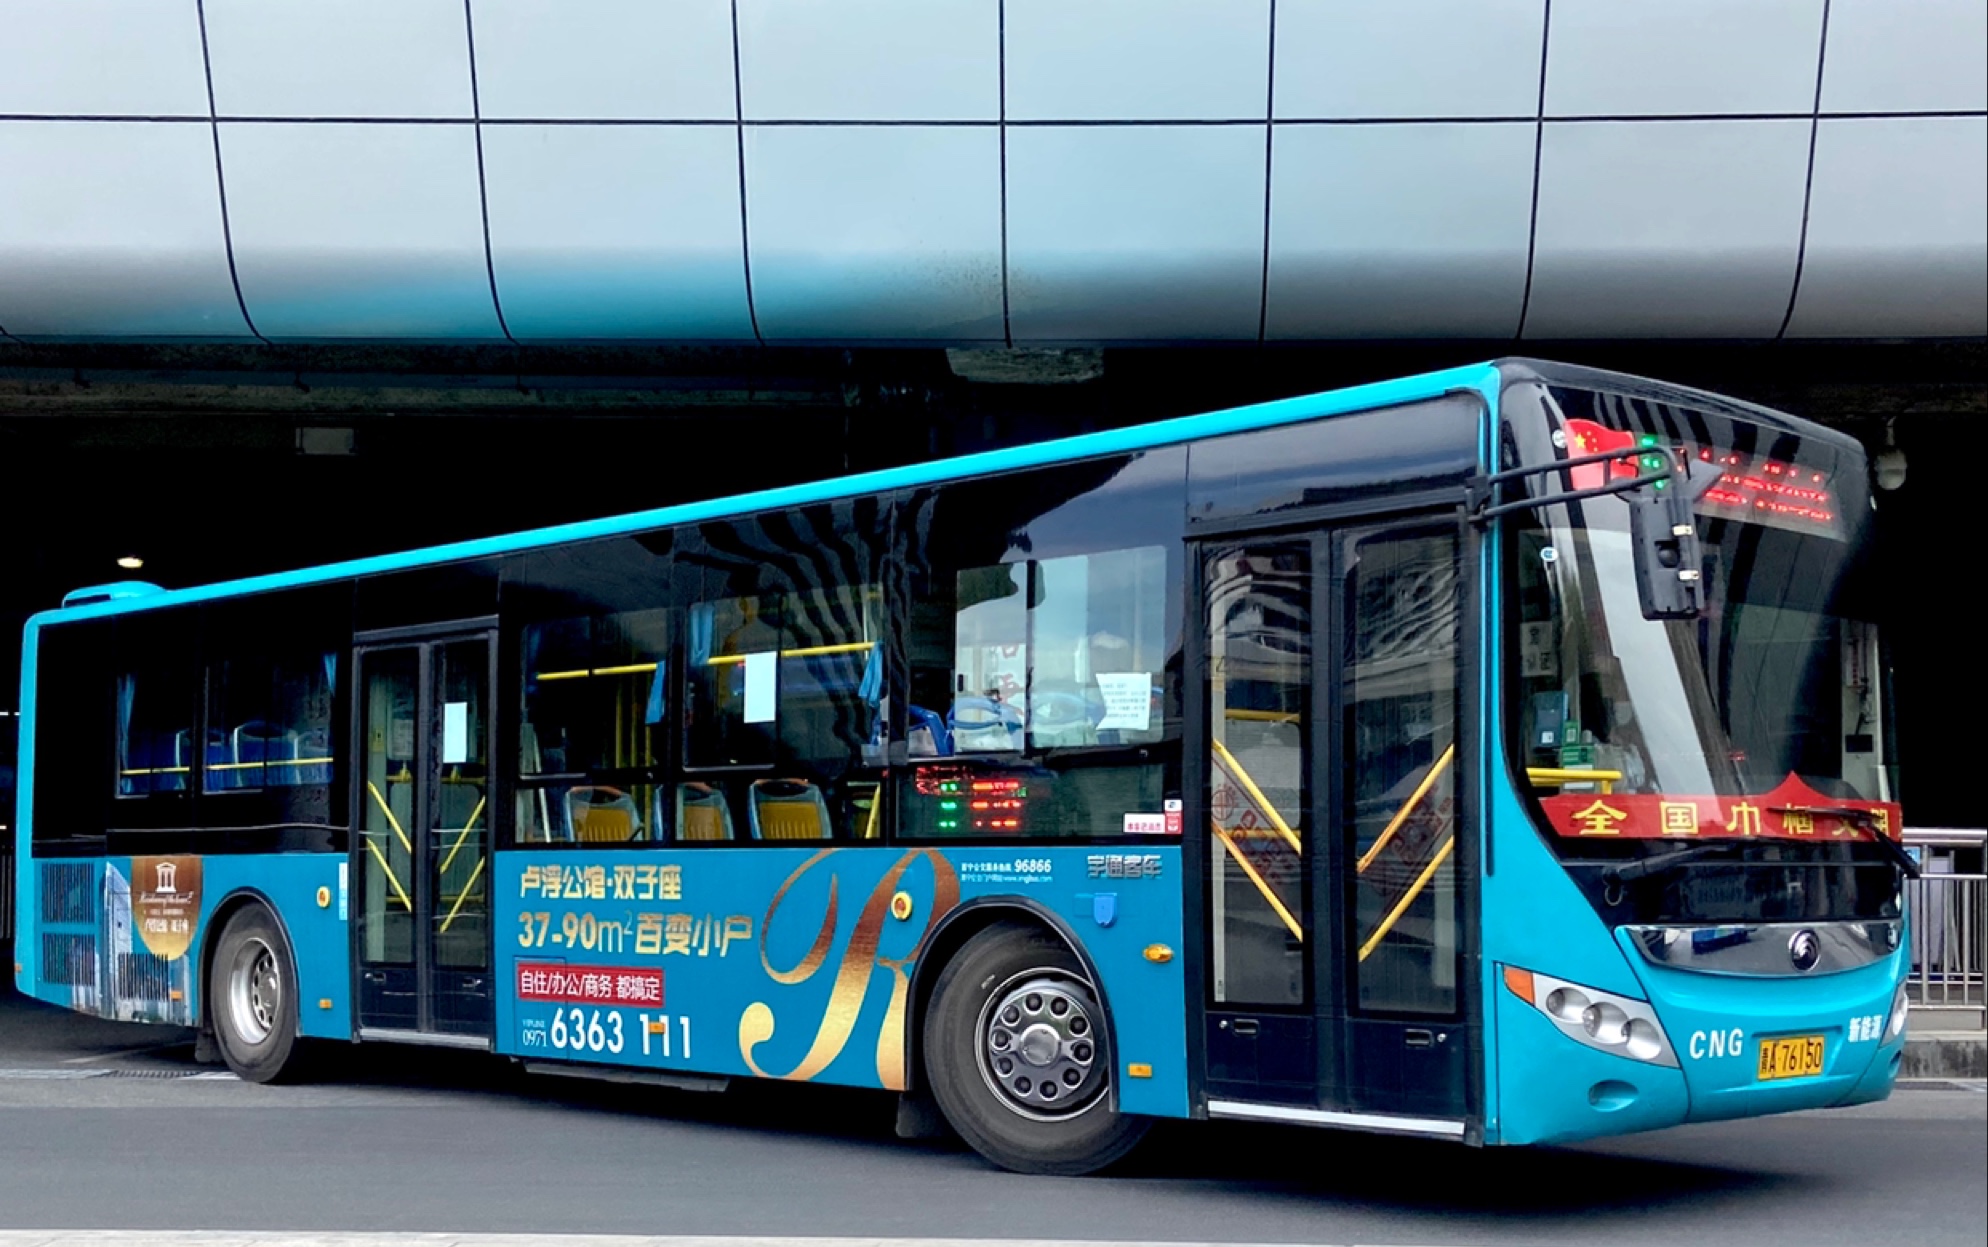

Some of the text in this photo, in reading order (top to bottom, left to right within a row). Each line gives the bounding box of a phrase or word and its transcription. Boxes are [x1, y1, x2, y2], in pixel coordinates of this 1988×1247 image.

[1014, 858, 1053, 873] 96866
[1087, 854, 1163, 878] 宇通客车
[522, 1007, 692, 1059] 0971 6363 111
[1689, 1028, 1744, 1060] CNG
